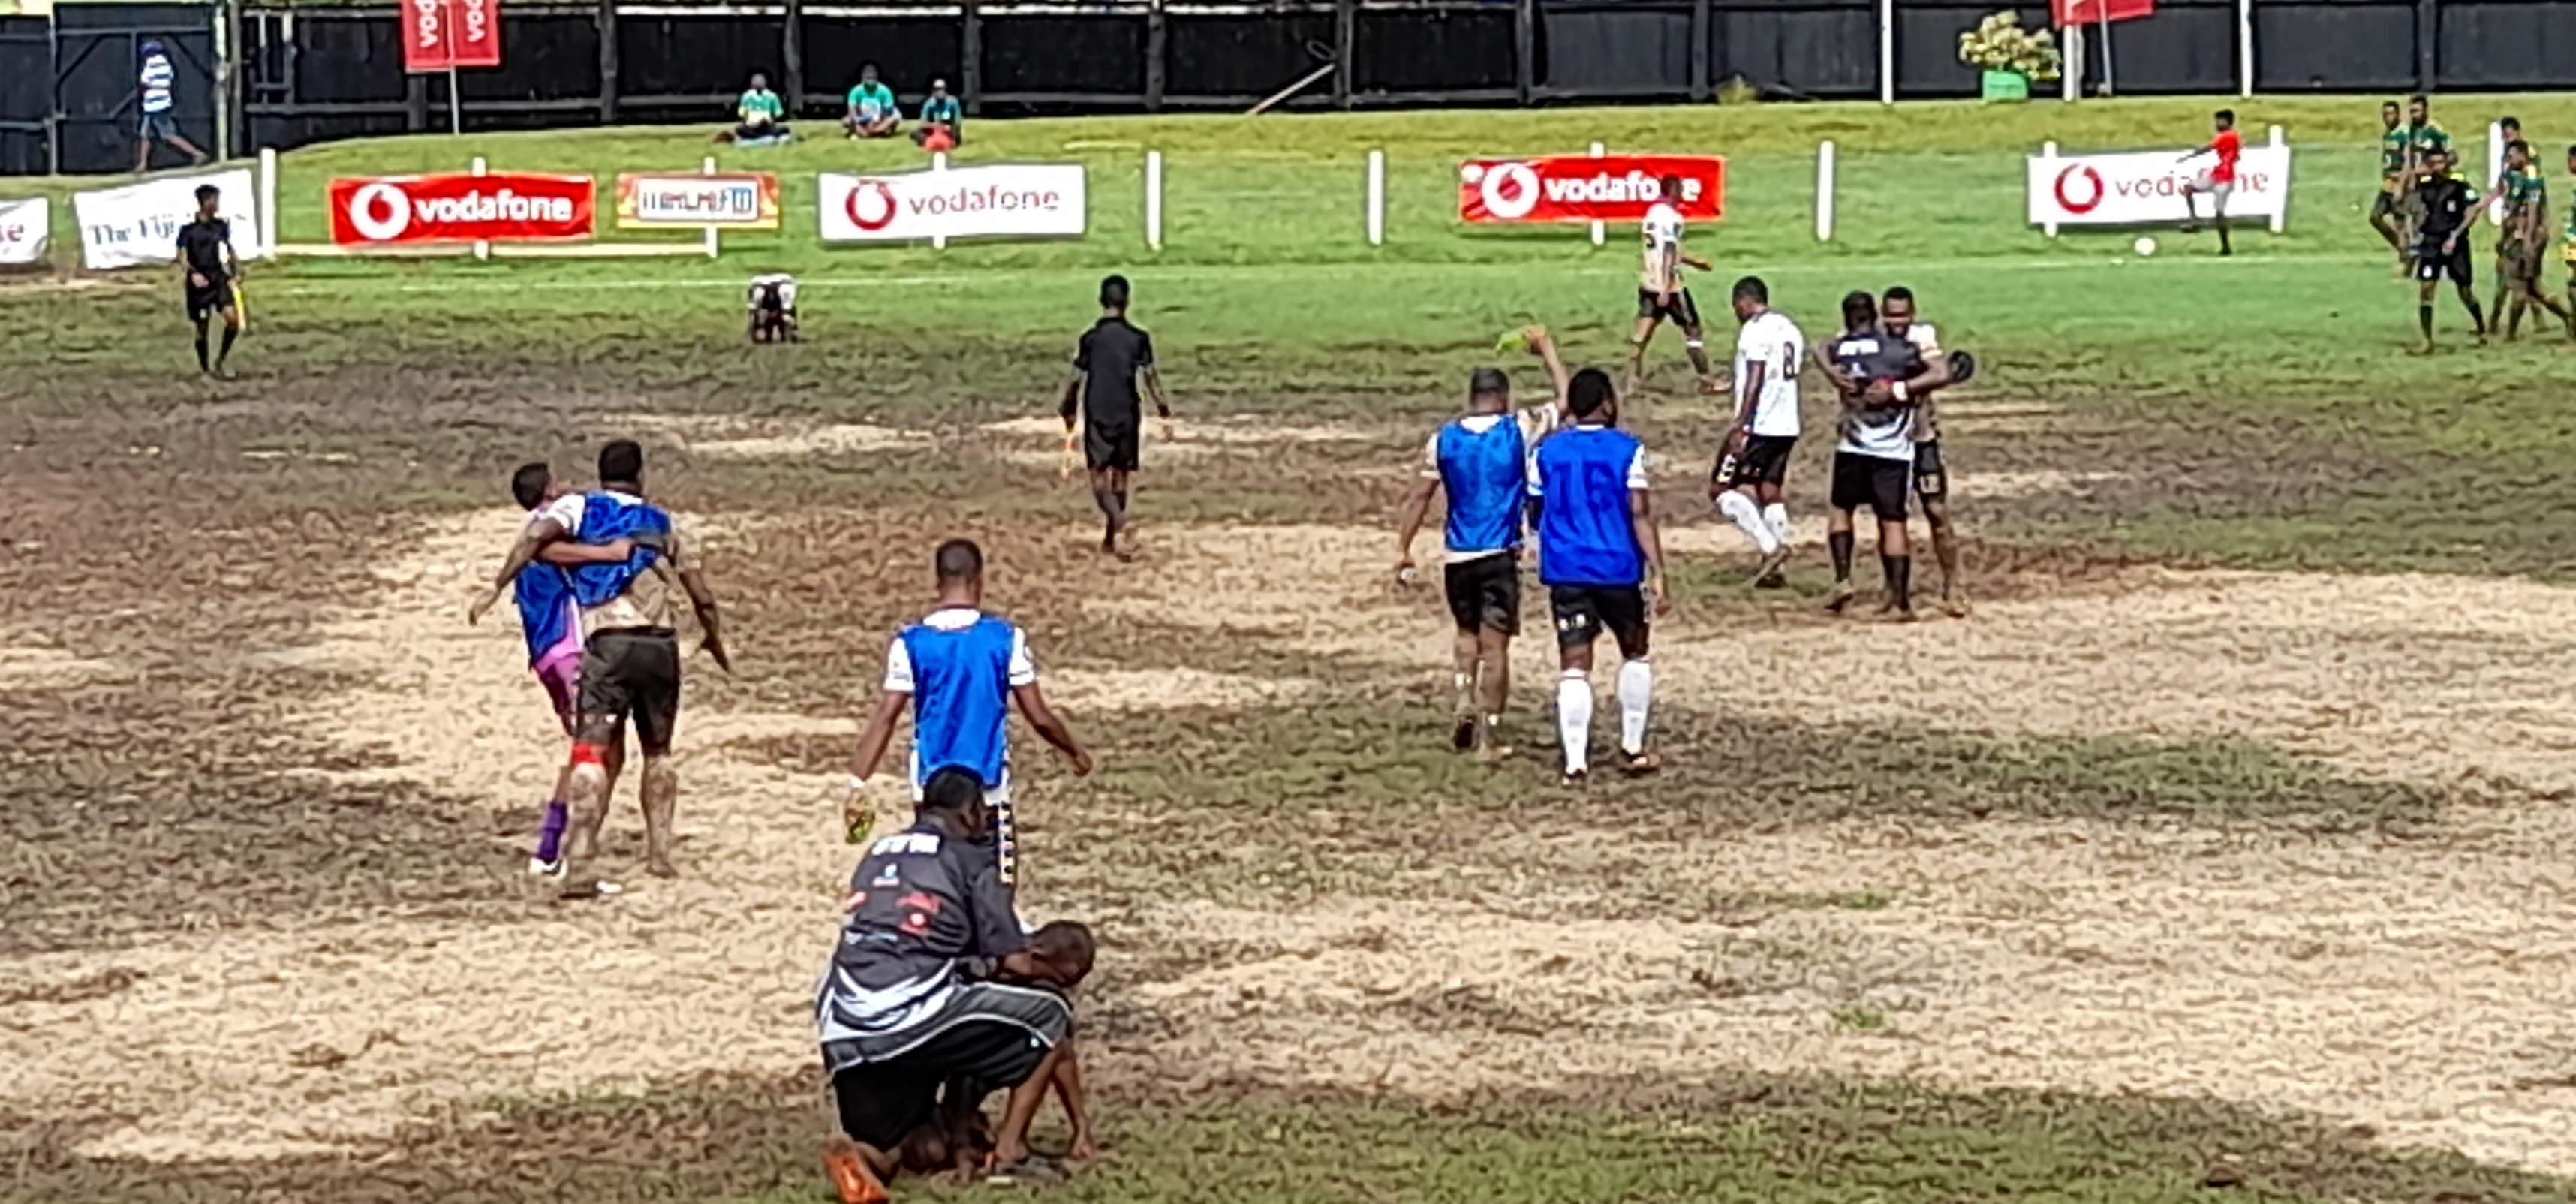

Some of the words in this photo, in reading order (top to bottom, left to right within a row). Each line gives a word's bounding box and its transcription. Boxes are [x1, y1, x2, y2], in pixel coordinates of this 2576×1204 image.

[909, 184, 1061, 215] vodafone
[1544, 170, 1701, 202] vodafoe
[414, 188, 572, 222] vodafone
